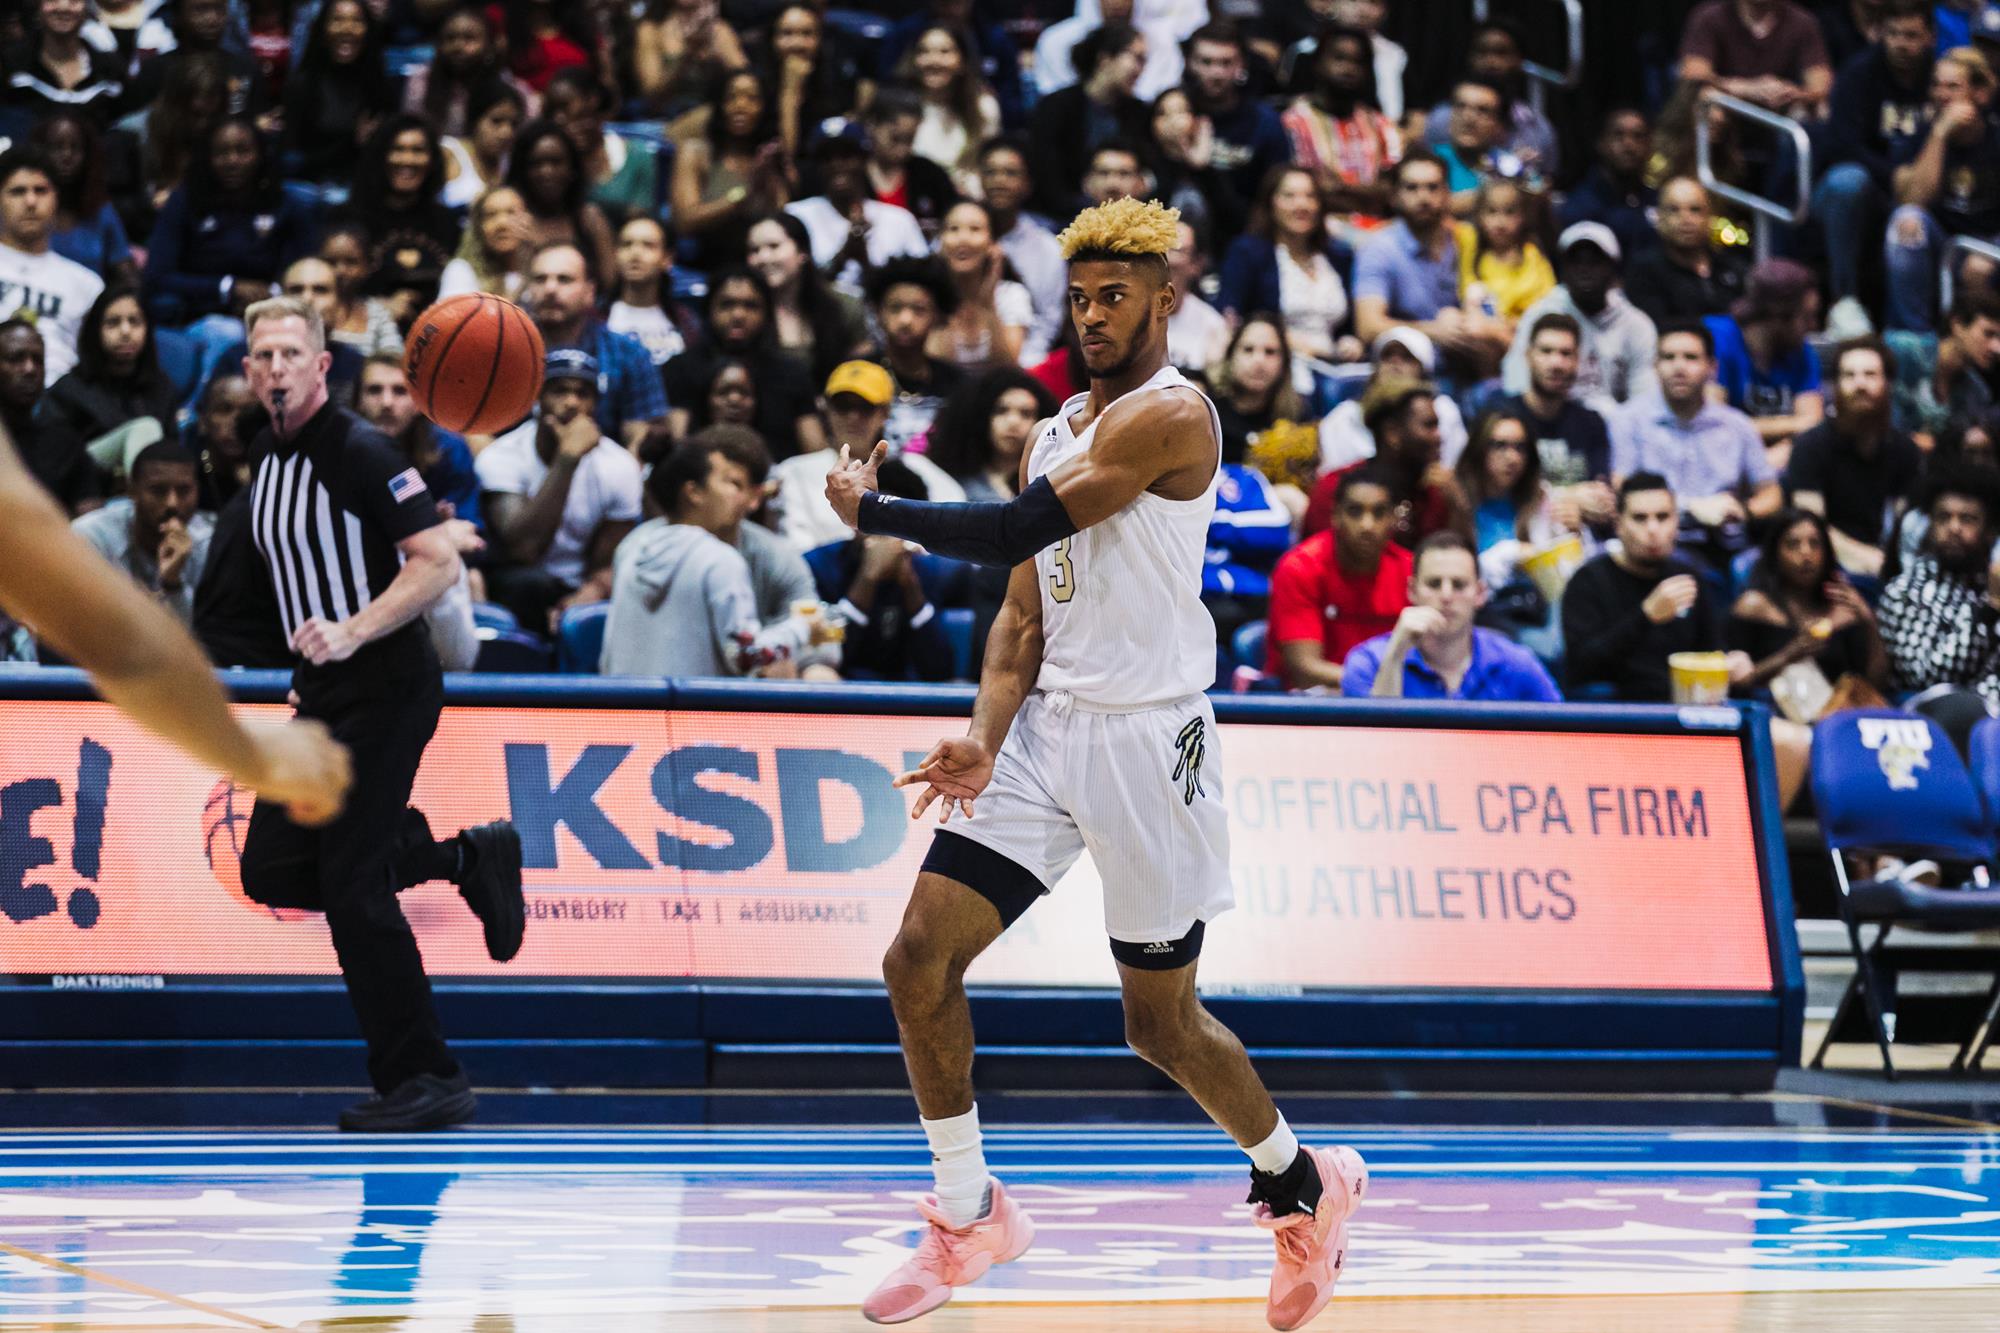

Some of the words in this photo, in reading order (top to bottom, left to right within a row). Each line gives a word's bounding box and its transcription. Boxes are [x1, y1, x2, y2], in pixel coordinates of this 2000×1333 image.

[1049, 536, 1075, 603] 3
[504, 743, 928, 873] KSD
[1234, 777, 1459, 833] OFFICIAL
[1477, 782, 1573, 835] CPA
[1588, 786, 1710, 838] FIRM
[661, 900, 702, 921] TAX
[1233, 865, 1291, 917] IU
[1307, 865, 1577, 921] ATHLETICS
[1143, 946, 1175, 954] adidas
